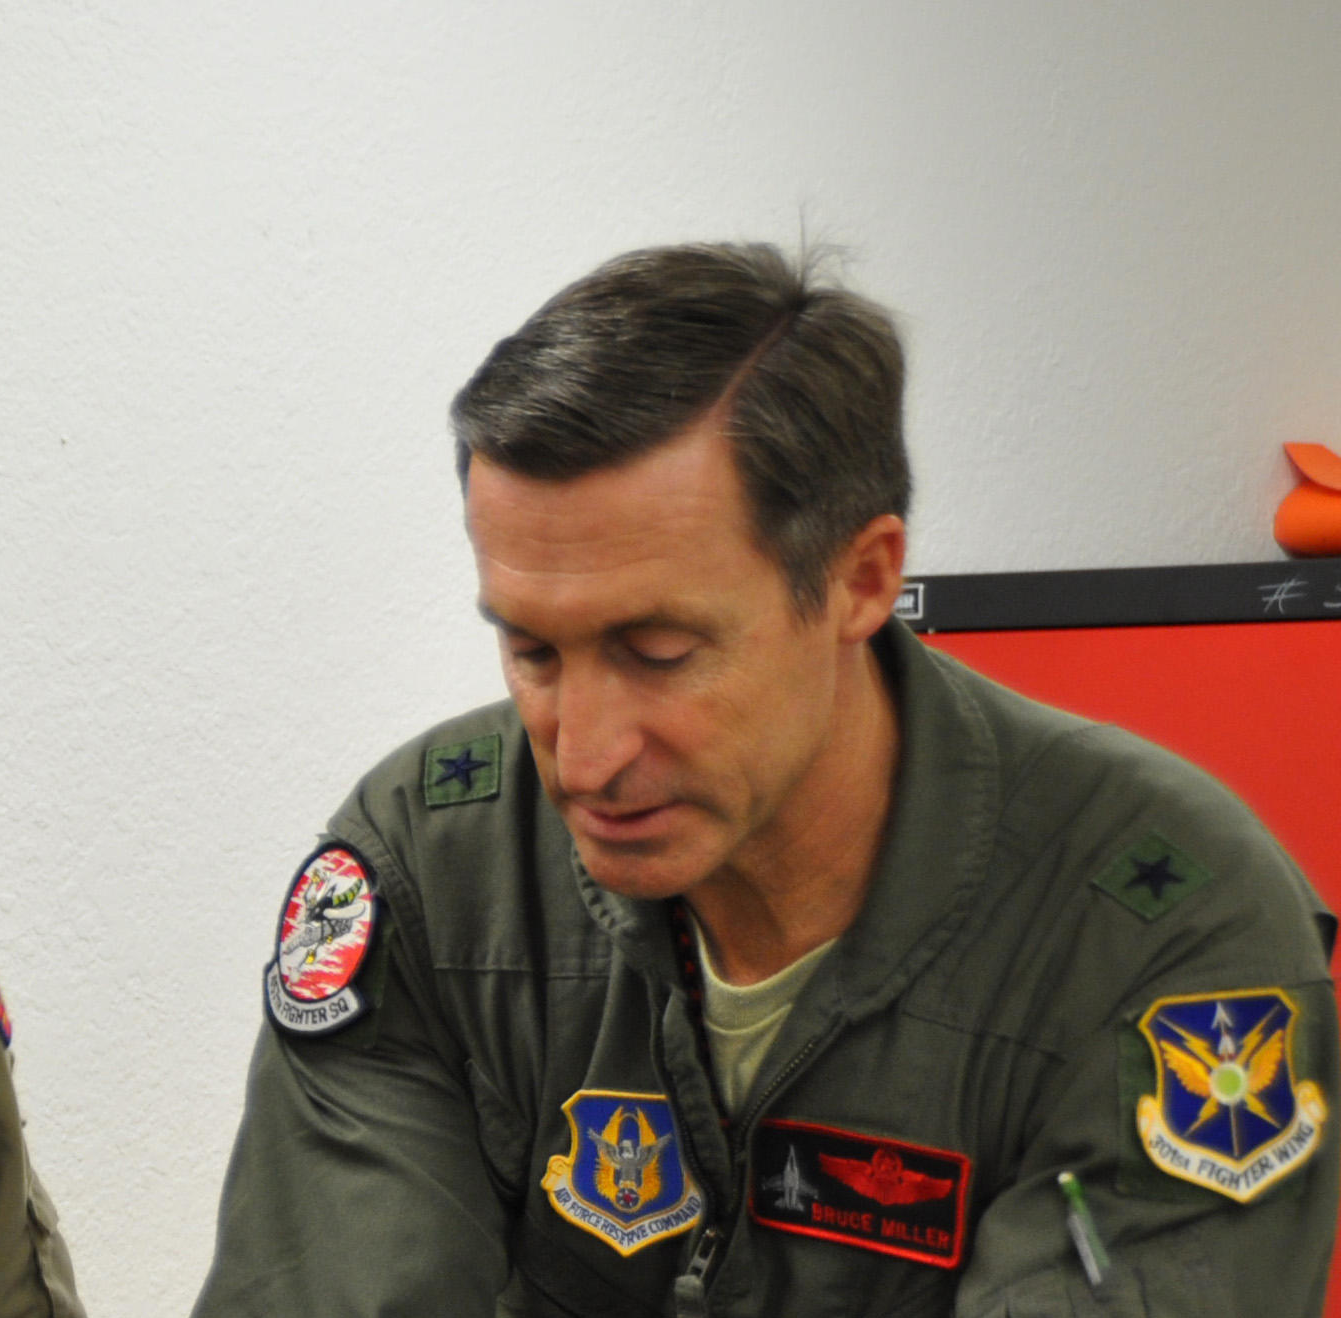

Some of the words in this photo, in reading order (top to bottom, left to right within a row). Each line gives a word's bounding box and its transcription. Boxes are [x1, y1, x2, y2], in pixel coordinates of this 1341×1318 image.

[280, 1001, 328, 1025] FIGHTER
[329, 996, 350, 1019] SQ
[1197, 1154, 1275, 1190] FIGHTER
[1270, 1120, 1315, 1166] WING
[554, 1187, 572, 1207] AIR
[567, 1201, 602, 1229] FORCE
[600, 1220, 650, 1247] RESERVE
[648, 1195, 702, 1235] COMMAND
[811, 1202, 875, 1234] BRUCE
[880, 1218, 951, 1249] MILLER
